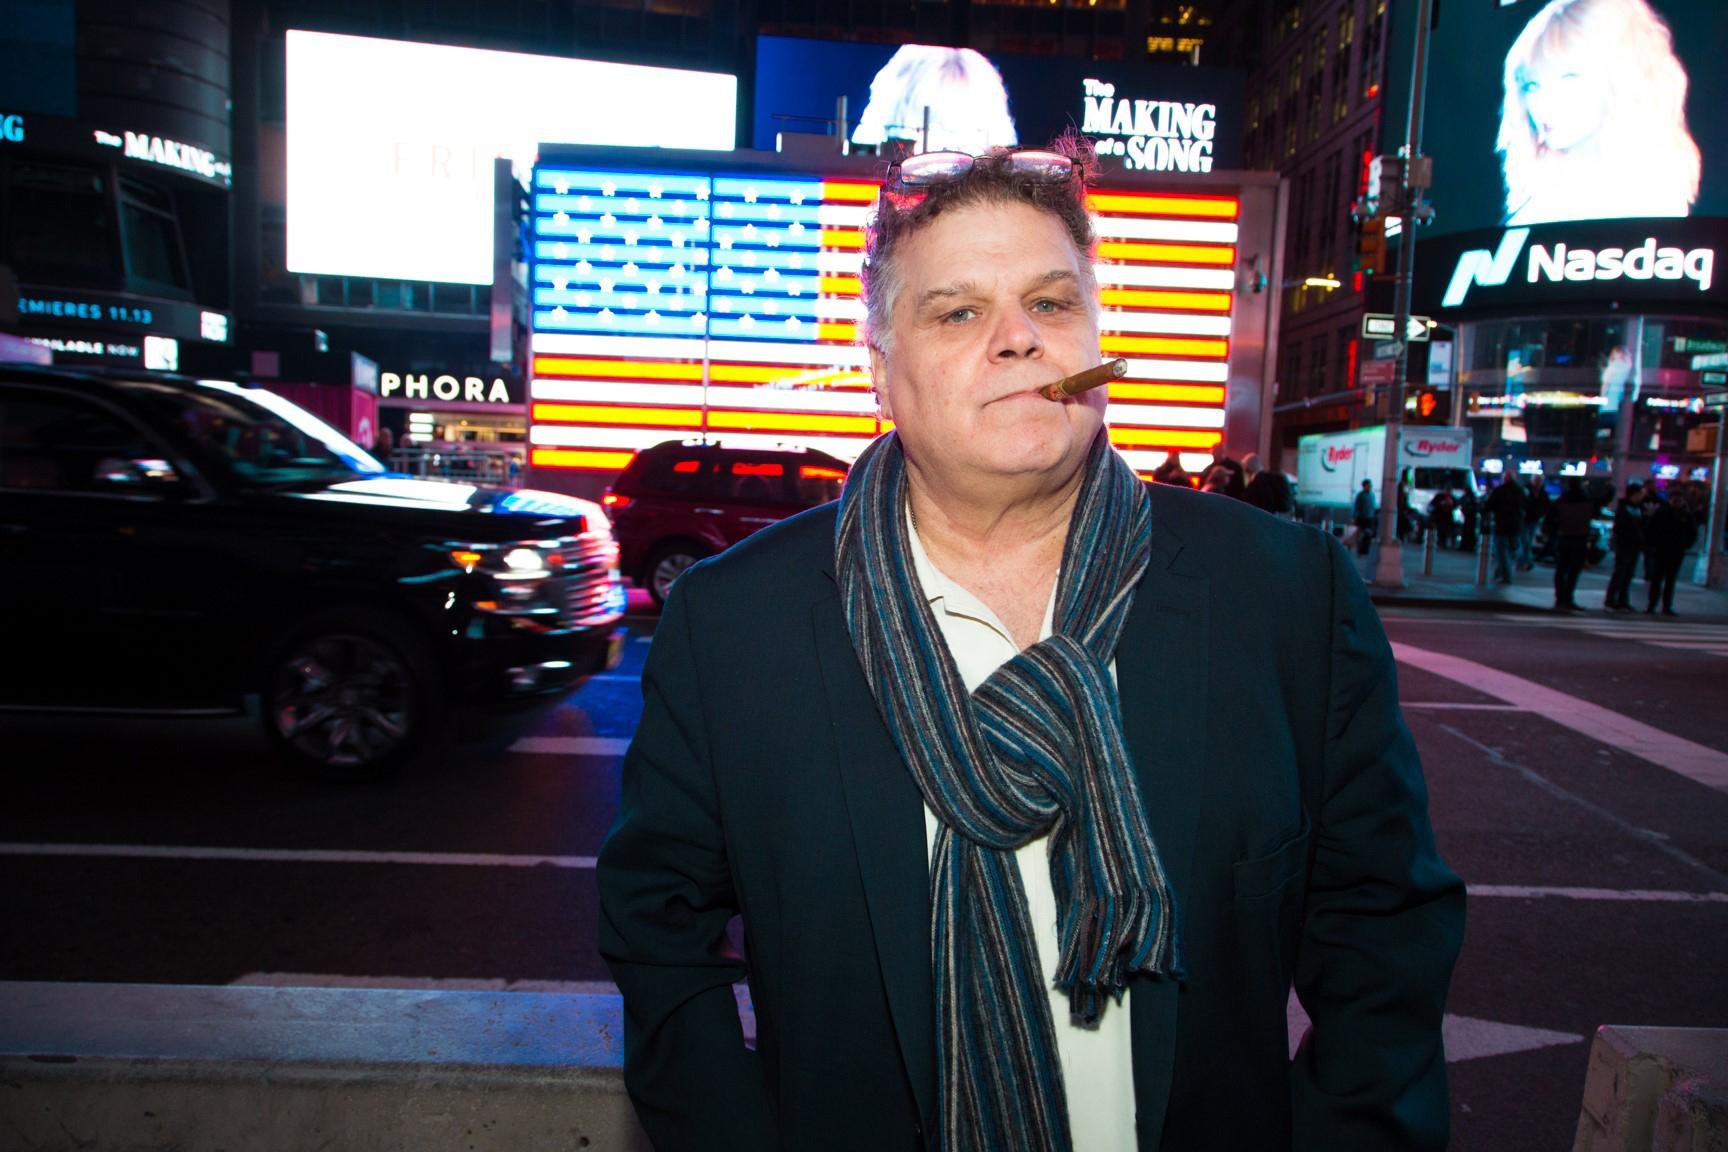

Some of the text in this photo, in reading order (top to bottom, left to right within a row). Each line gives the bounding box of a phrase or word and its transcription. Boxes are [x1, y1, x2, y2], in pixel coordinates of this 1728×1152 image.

[1083, 79, 1115, 97] The
[1082, 97, 1216, 140] MAKING
[124, 131, 215, 178] MAKING
[1126, 135, 1214, 172] SONG
[1527, 238, 1714, 291] Nasdaq
[381, 372, 510, 403] PHORA
[1327, 445, 1354, 465] Ryder
[1417, 439, 1461, 454] Ryder
